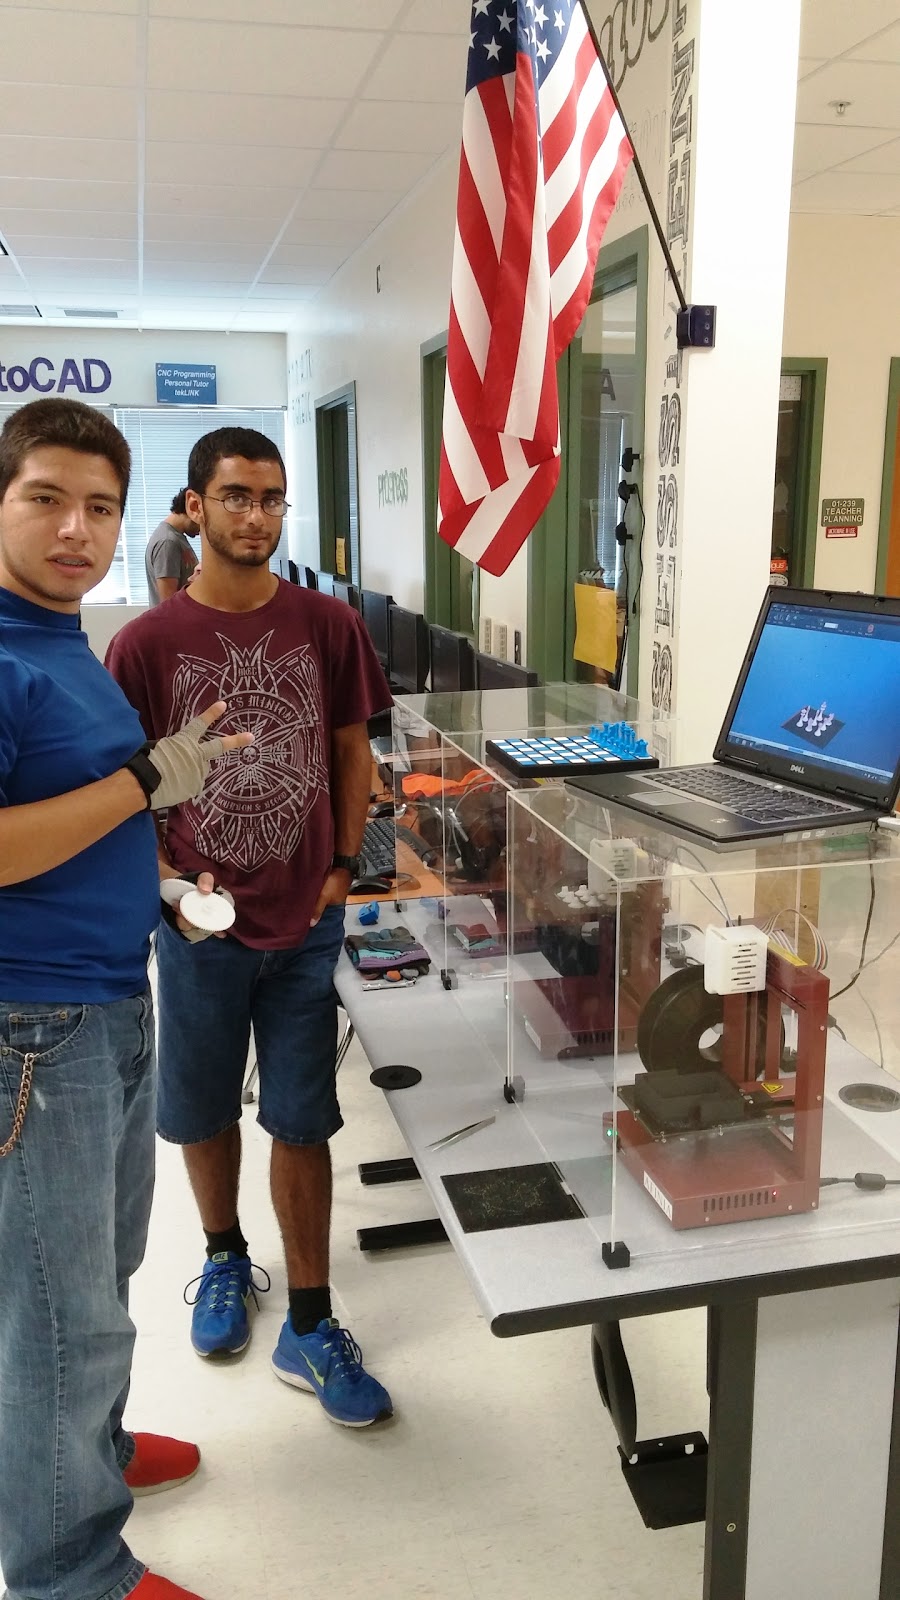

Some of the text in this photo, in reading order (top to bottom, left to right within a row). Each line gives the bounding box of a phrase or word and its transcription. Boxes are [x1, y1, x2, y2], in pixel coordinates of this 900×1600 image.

[157, 369, 216, 380] CNC Programming
[164, 379, 192, 387] Personal
[825, 507, 862, 515] TEACHER
[823, 515, 863, 523] PLANNING
[248, 694, 295, 722] MINION
[790, 764, 805, 774] DELL
